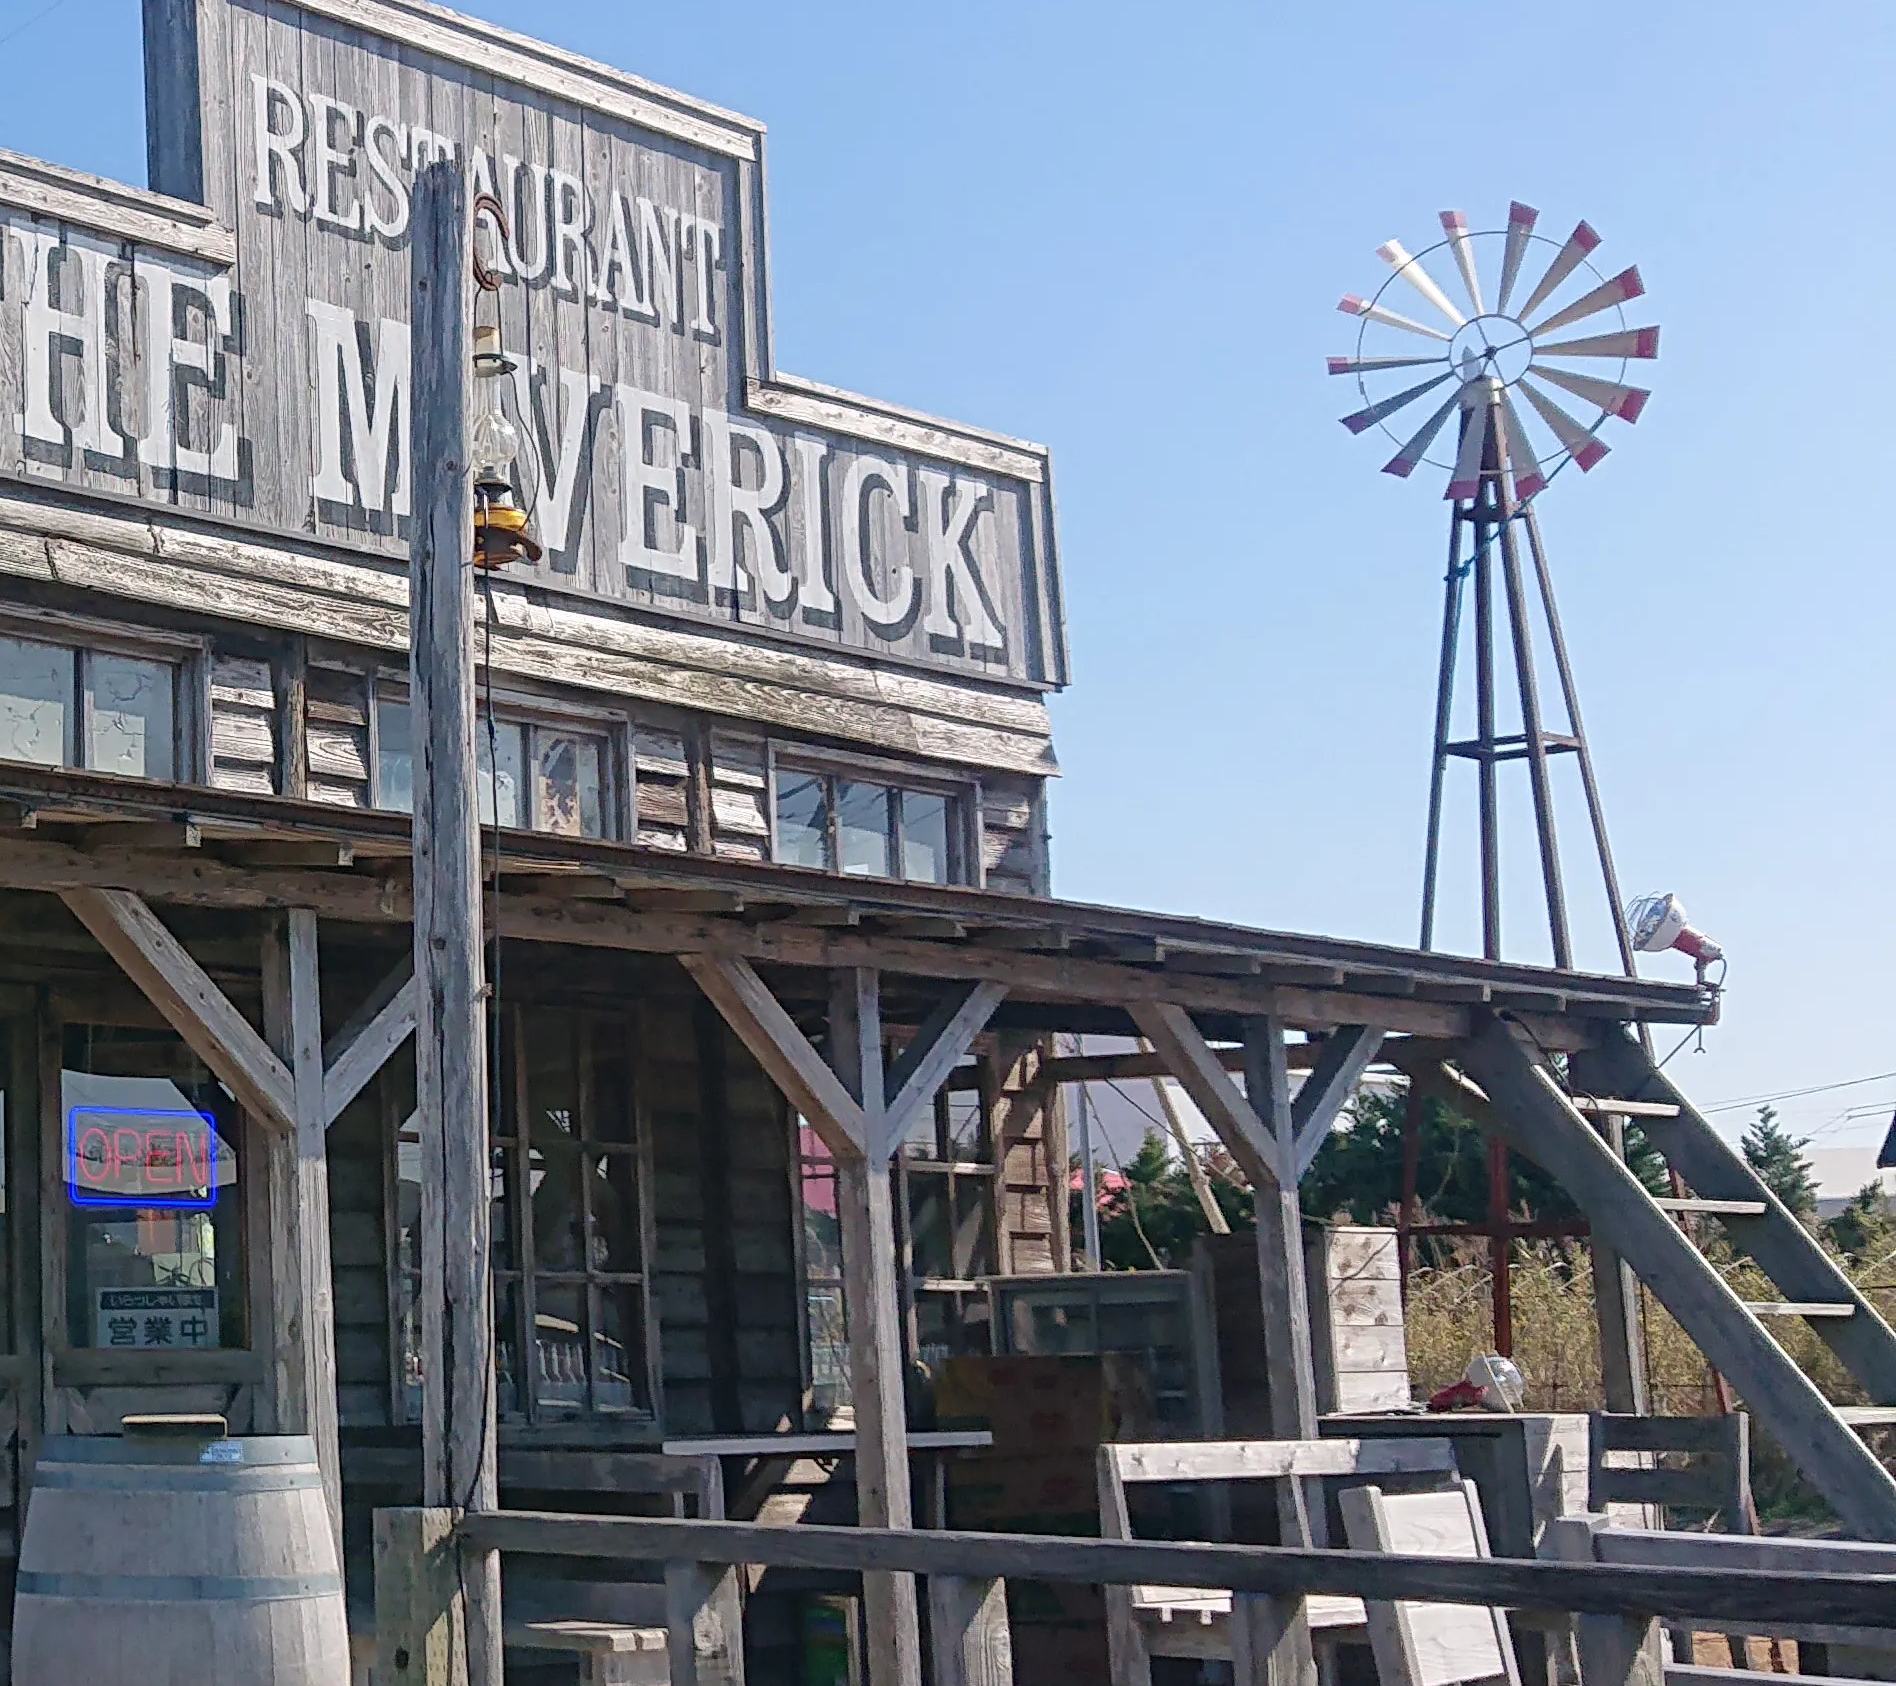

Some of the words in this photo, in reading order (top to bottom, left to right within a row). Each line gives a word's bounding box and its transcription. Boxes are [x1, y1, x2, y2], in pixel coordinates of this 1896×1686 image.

[250, 72, 725, 347] RESAURANT
[307, 298, 1007, 660] MVERICK
[79, 1127, 207, 1184] OPEN
[108, 1315, 208, 1346] 営業中
